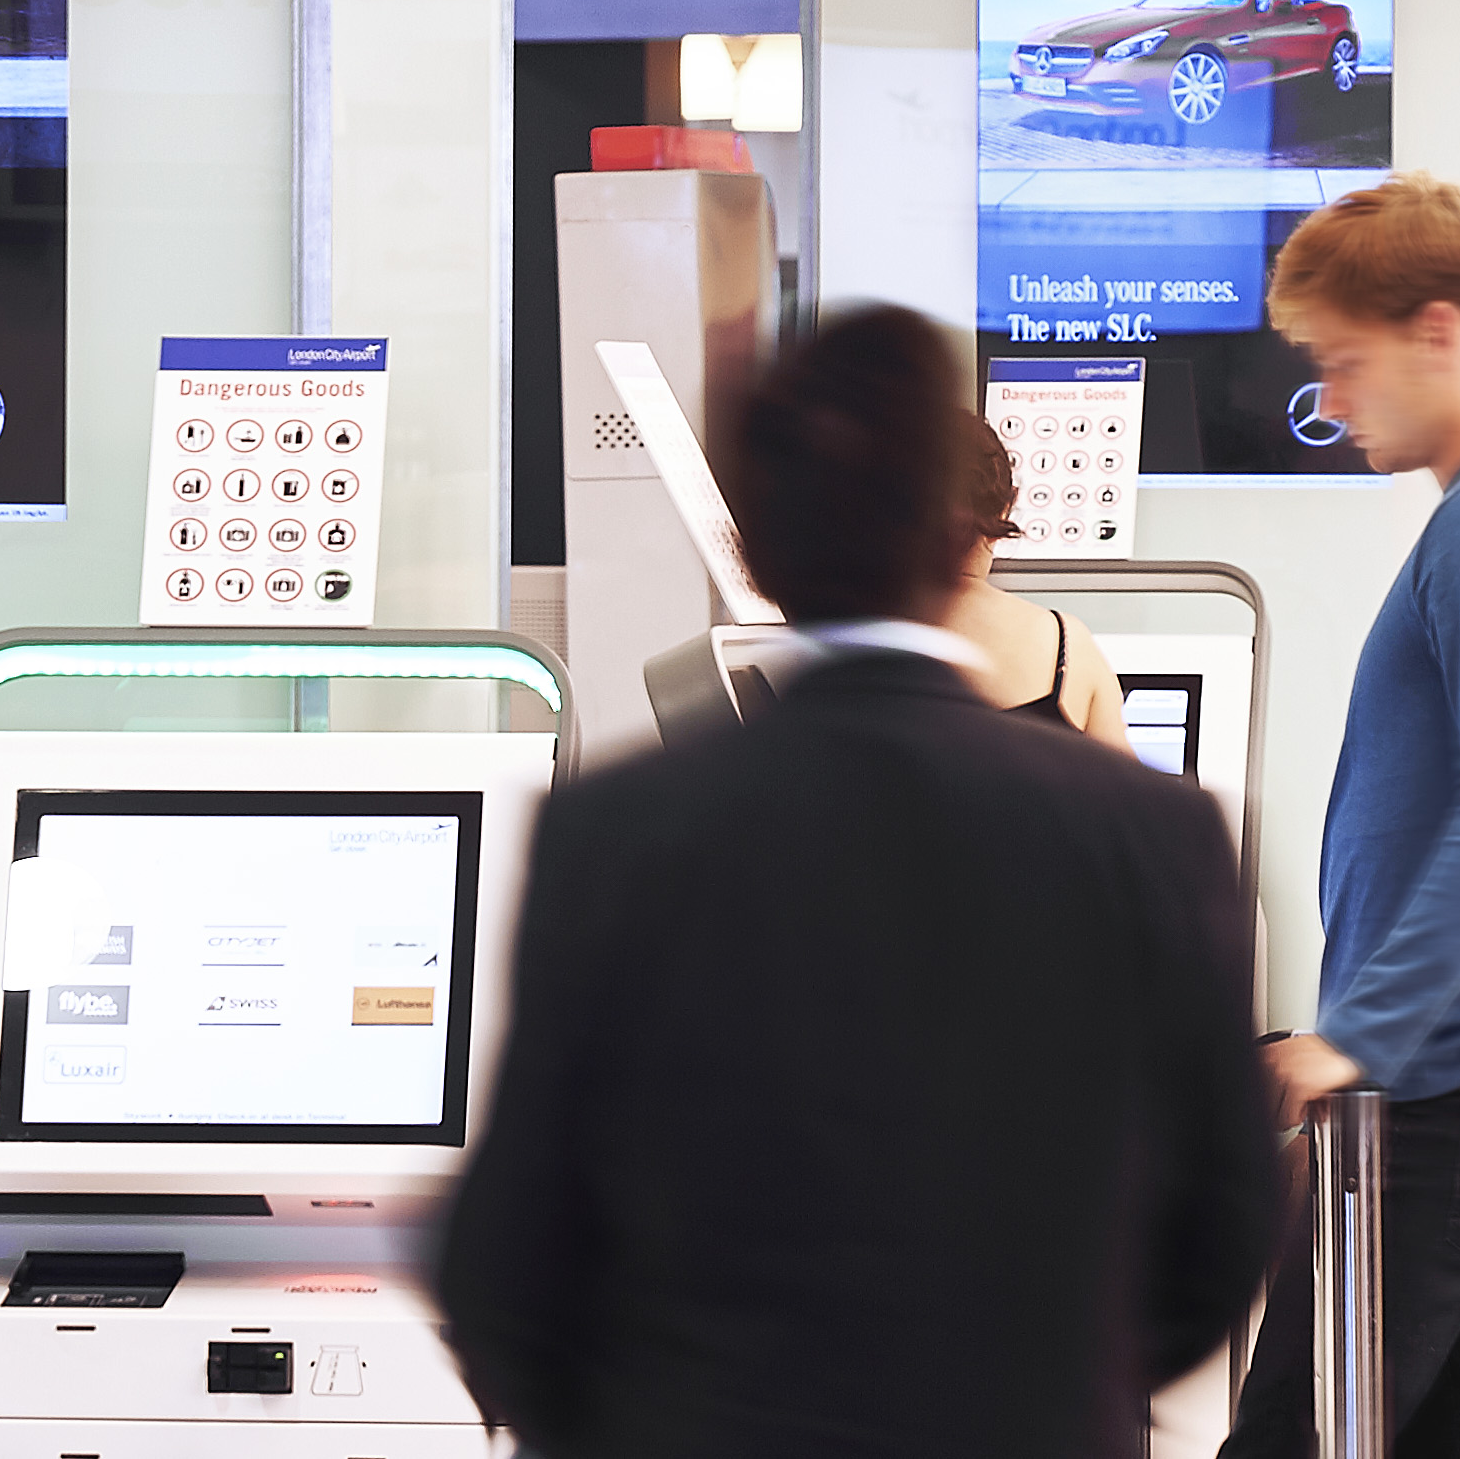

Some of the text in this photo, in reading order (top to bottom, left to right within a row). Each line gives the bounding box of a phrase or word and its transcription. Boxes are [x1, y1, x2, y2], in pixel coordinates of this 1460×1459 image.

[1009, 274, 1239, 309] Unleash your senses.
[1007, 313, 1157, 342] The new SLC.
[180, 379, 366, 401] Dangerous Goods
[1002, 388, 1127, 403] Dangerous Goods
[330, 830, 448, 845] London City Airport
[61, 1063, 121, 1077] Luxair
